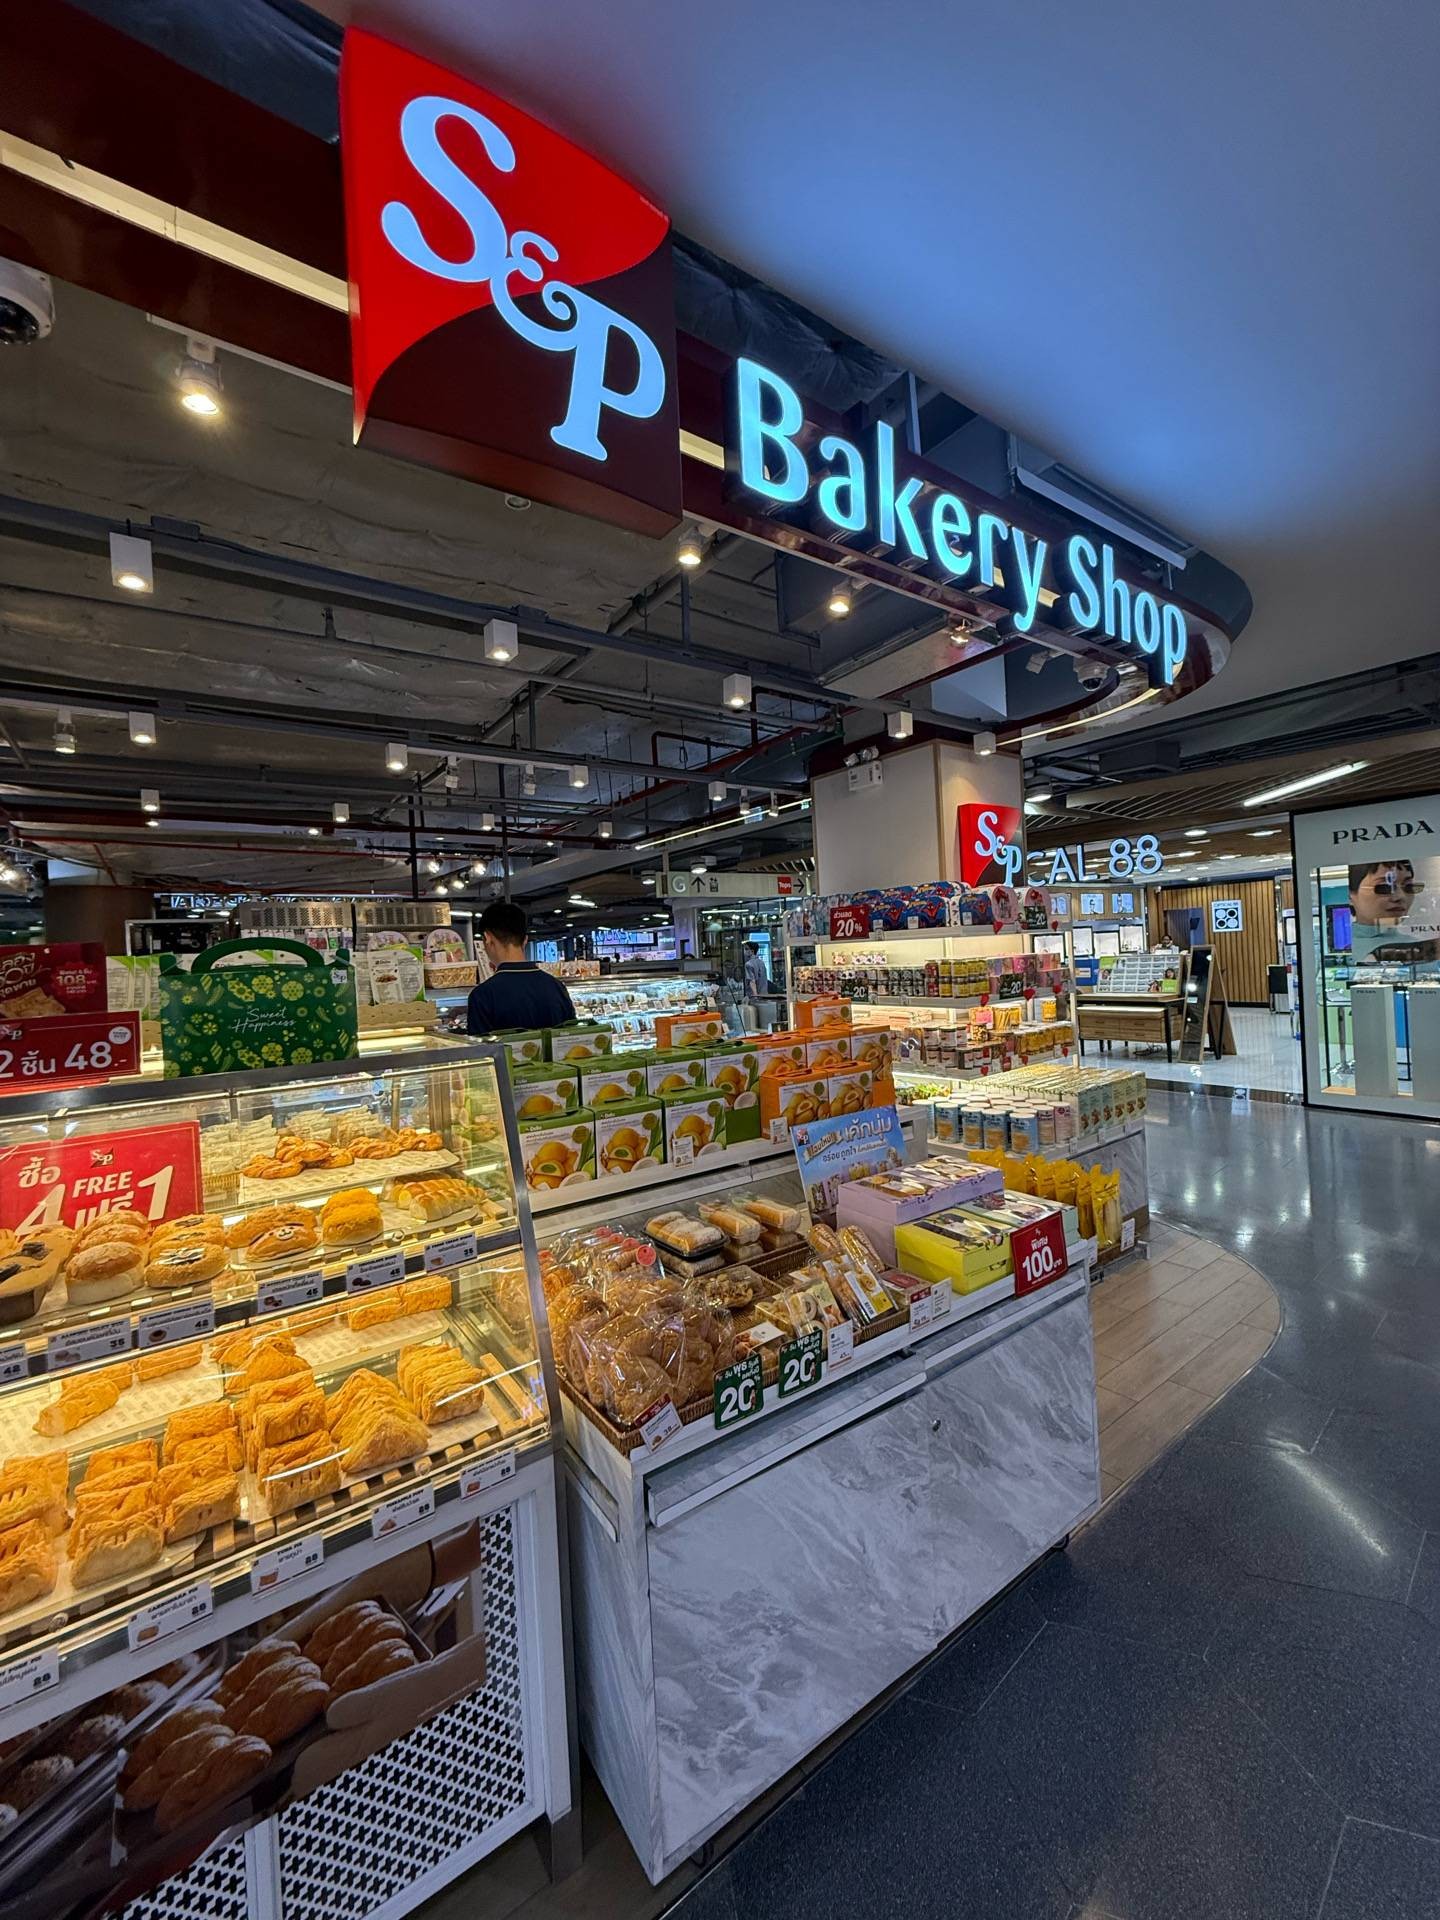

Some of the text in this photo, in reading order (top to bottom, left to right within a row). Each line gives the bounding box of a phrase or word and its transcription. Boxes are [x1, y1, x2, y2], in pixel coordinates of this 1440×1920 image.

[381, 95, 666, 461] S&P
[737, 356, 1189, 685] Bakery Shop
[1332, 819, 1435, 845] PRADA
[974, 811, 1023, 888] S&P
[1108, 834, 1163, 879] 88
[672, 876, 686, 893] G
[836, 919, 862, 937] 20%
[56, 975, 86, 986] 108
[231, 1018, 297, 1034] Happiness
[247, 1006, 286, 1022] Sweet
[20, 1050, 56, 1076] ชิ้น
[18, 1157, 62, 1188] ซื้อ
[72, 1170, 134, 1198] FREE
[138, 1165, 174, 1221] 1
[1022, 1246, 1054, 1281] 100
